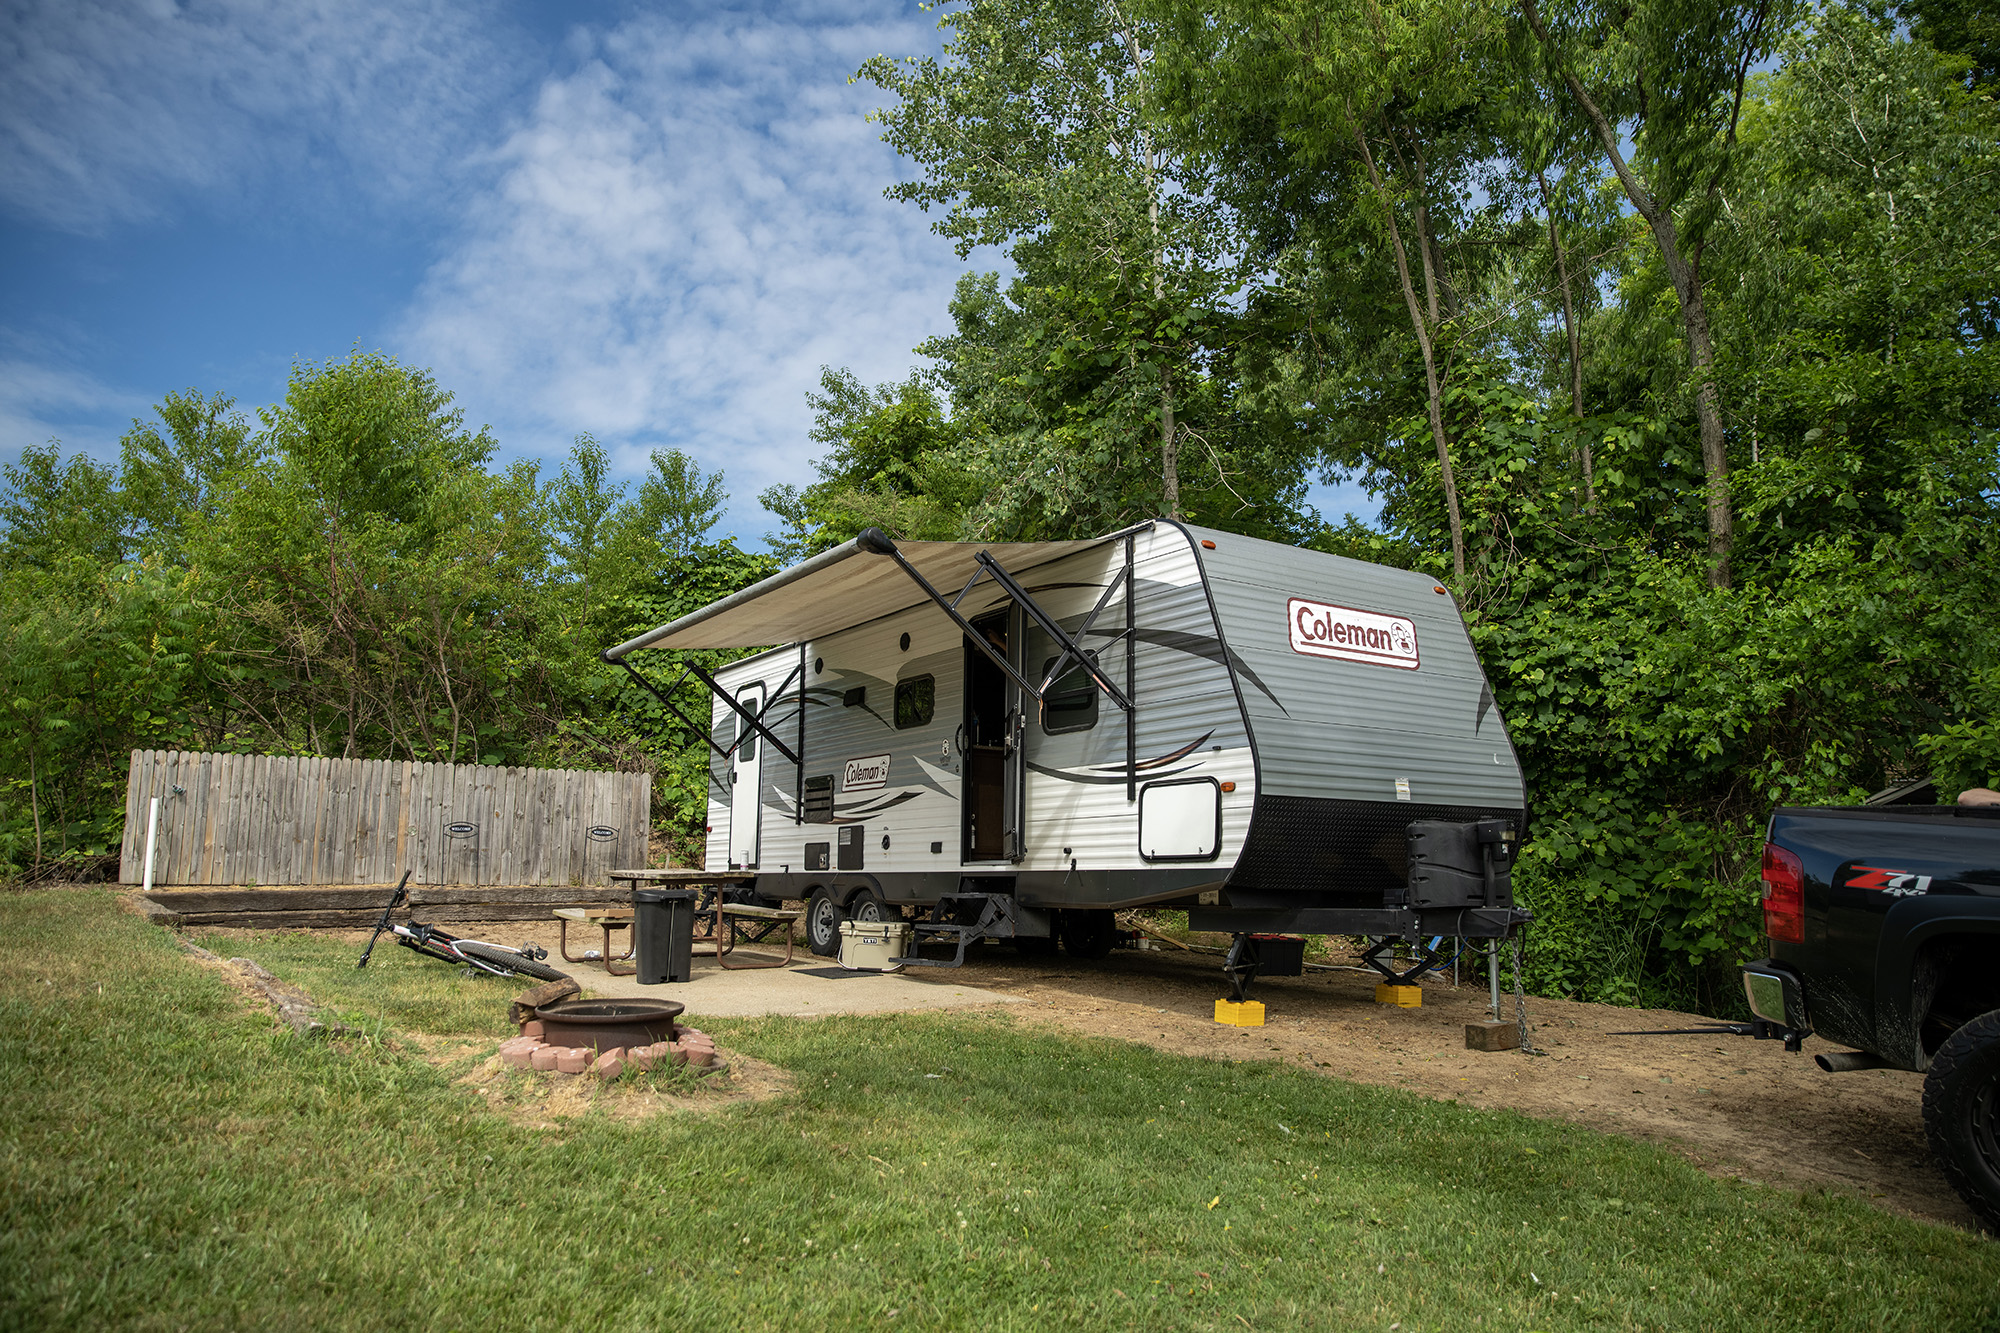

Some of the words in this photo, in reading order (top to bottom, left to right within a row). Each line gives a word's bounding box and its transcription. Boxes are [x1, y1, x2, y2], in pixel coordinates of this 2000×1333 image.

[1297, 606, 1393, 651] Coleman
[846, 763, 879, 783] Coleman
[1845, 865, 1932, 891] Z71
